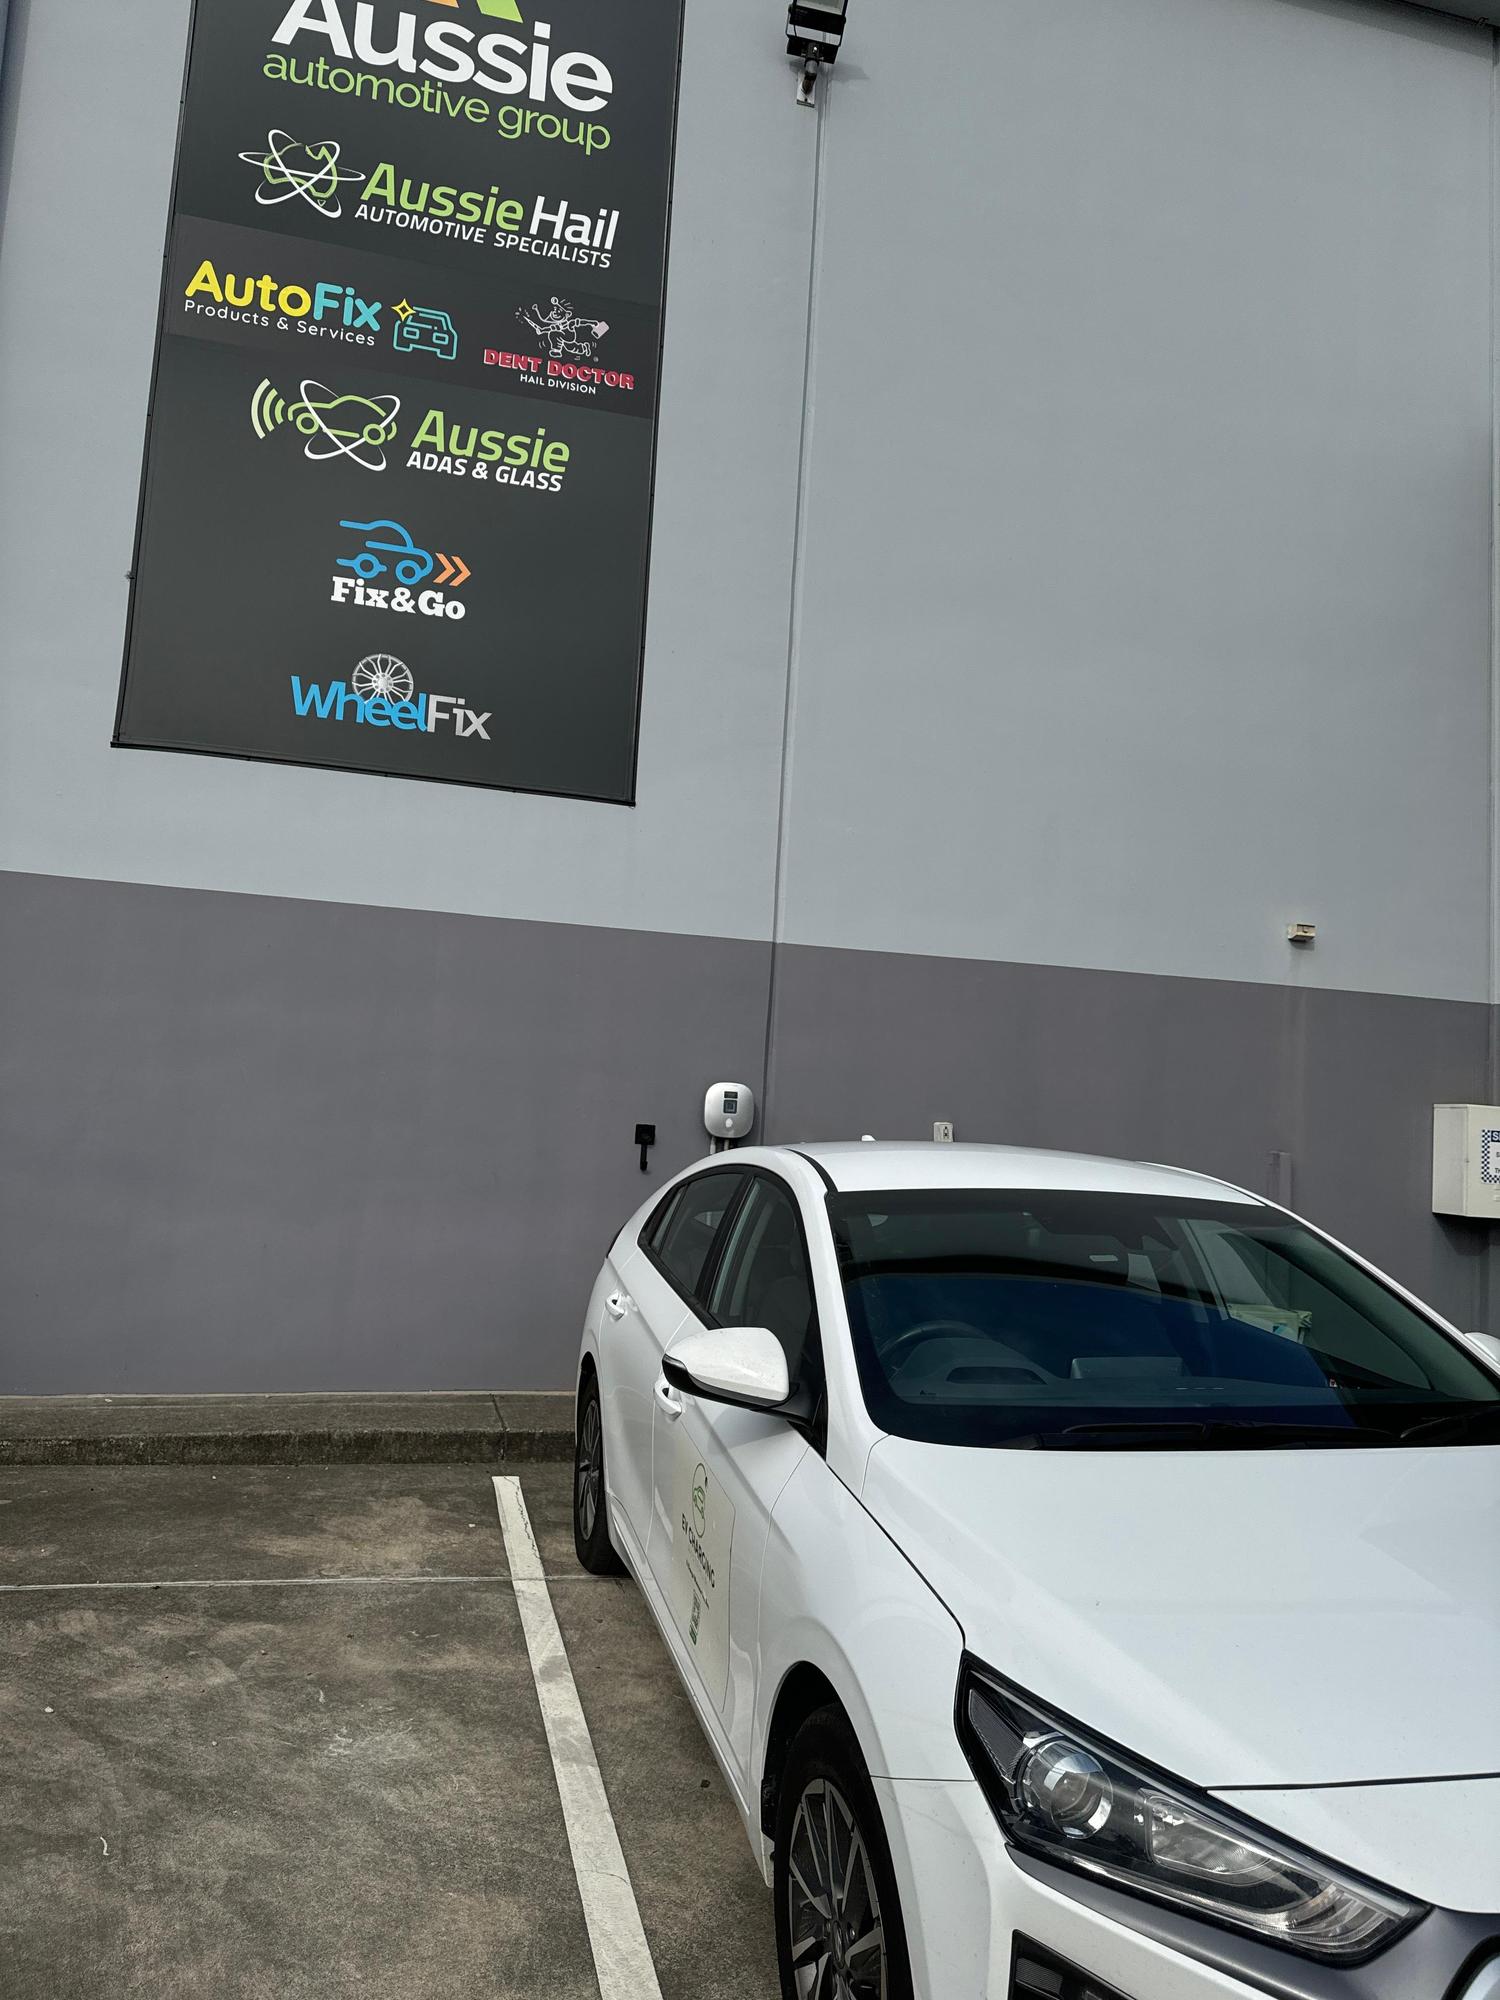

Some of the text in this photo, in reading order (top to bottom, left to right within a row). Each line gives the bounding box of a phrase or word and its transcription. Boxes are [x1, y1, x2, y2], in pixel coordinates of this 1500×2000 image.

[272, 0, 612, 112] Aussie
[262, 51, 611, 155] automotive group
[355, 204, 612, 269] AUTOMOTIVE SPECIALISTS
[360, 162, 620, 250] Aussie Hail
[184, 300, 376, 346] Products & Services
[185, 260, 382, 332] AutoFix
[484, 348, 635, 390] DENT DOCTOR
[519, 373, 596, 395] HAIL DIVISION
[406, 451, 562, 492] ADAS & GLASS
[411, 409, 570, 473] Aussie
[331, 576, 466, 620] Fix&Go
[291, 675, 492, 741] WheelFix
